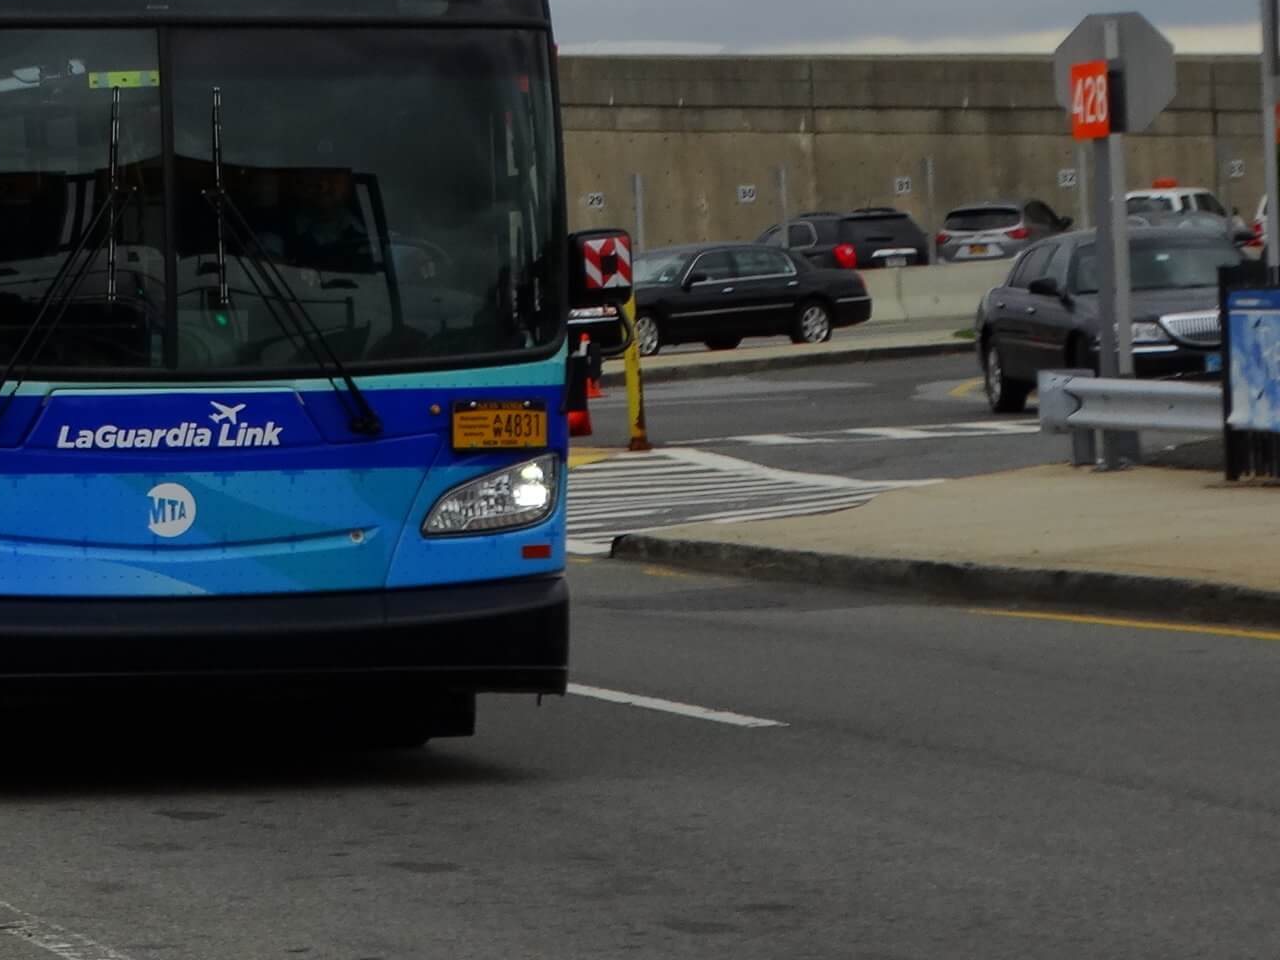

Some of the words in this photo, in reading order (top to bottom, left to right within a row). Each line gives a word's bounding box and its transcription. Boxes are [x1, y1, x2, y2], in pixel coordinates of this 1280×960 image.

[1072, 75, 1108, 124] 428
[56, 422, 212, 449] LaGuardia
[217, 421, 283, 448] Link
[148, 496, 187, 525] MTA
